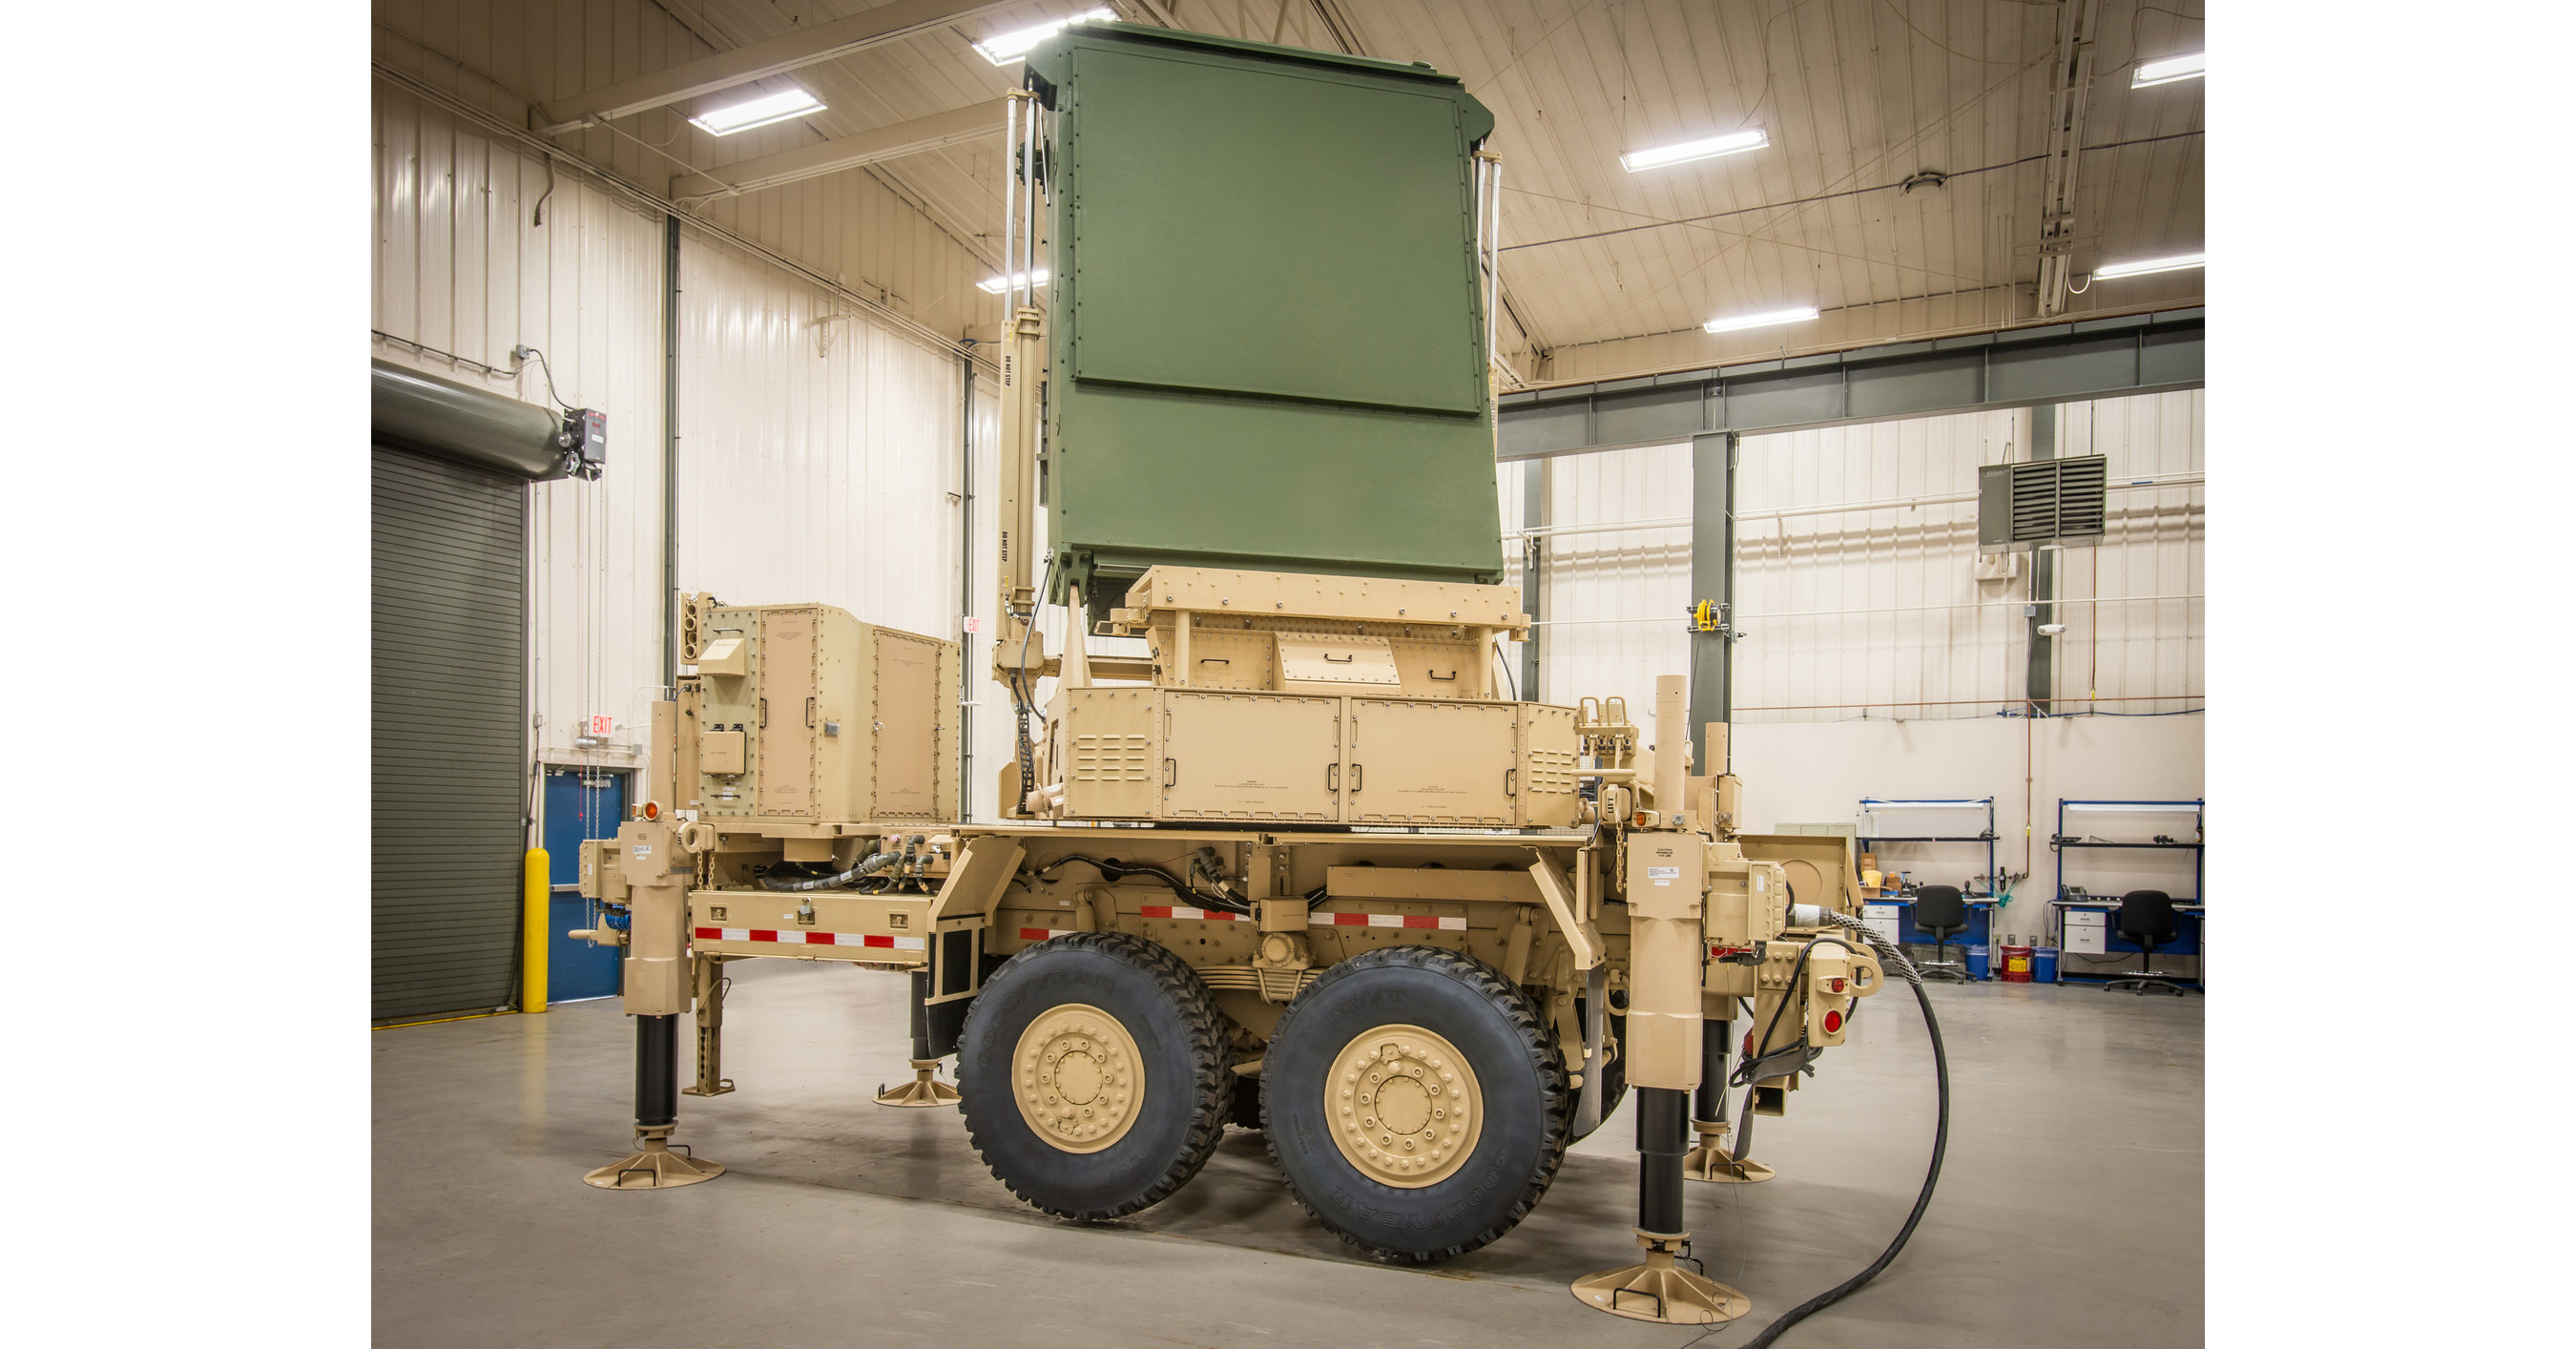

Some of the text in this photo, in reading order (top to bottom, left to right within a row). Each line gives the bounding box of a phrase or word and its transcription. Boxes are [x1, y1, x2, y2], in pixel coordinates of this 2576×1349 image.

[968, 618, 980, 633] EXIT
[592, 716, 613, 735] EXIT
[977, 970, 1114, 1070] GOODYEAR
[1330, 1144, 1513, 1230] GOODYEAR
